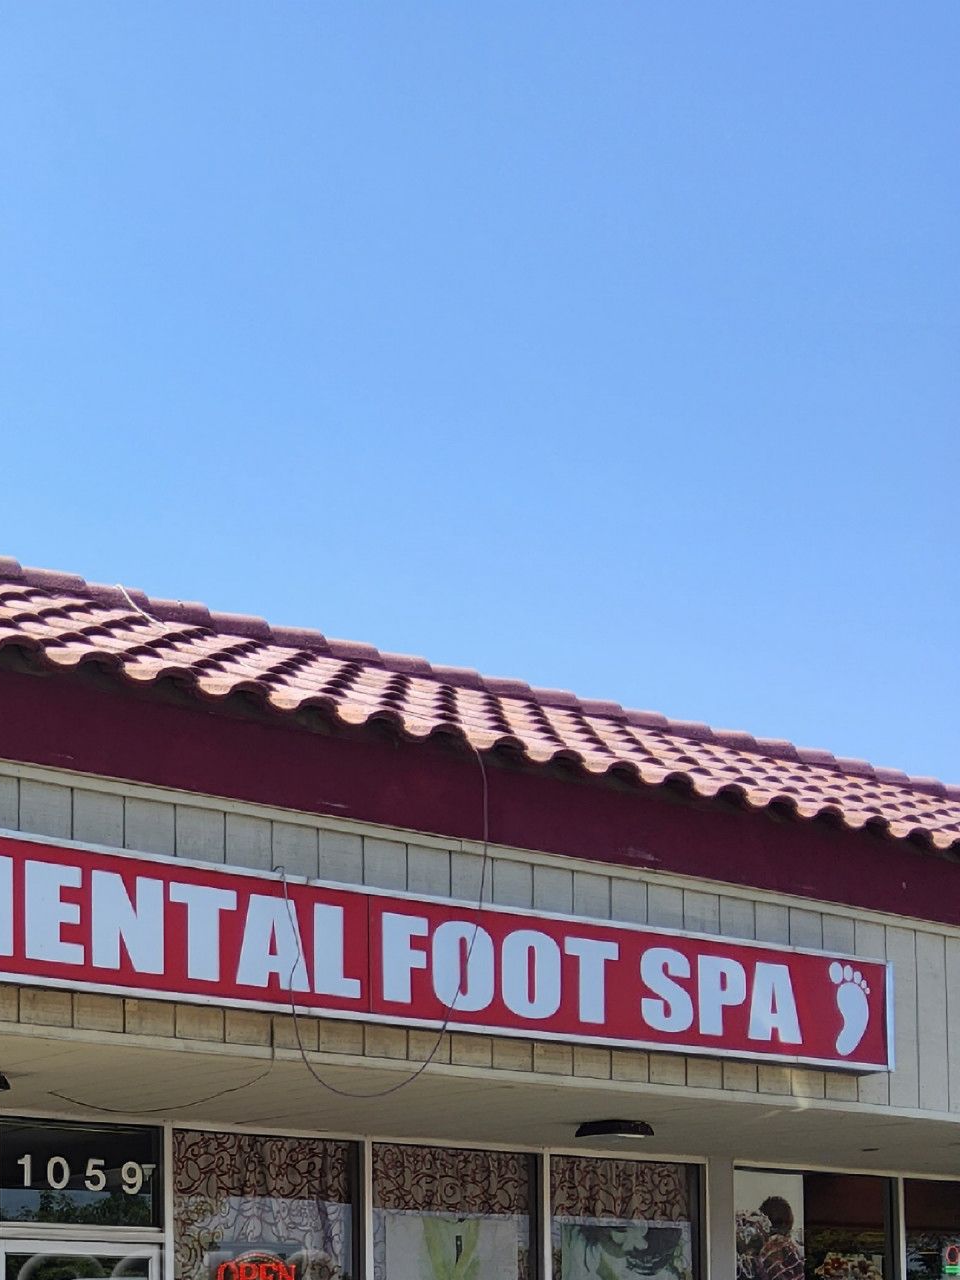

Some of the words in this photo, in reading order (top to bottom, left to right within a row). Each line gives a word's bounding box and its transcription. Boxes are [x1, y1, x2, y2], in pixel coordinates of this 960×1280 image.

[381, 911, 619, 1024] FOOT
[640, 947, 802, 1045] SPA
[17, 1154, 143, 1195] 1059
